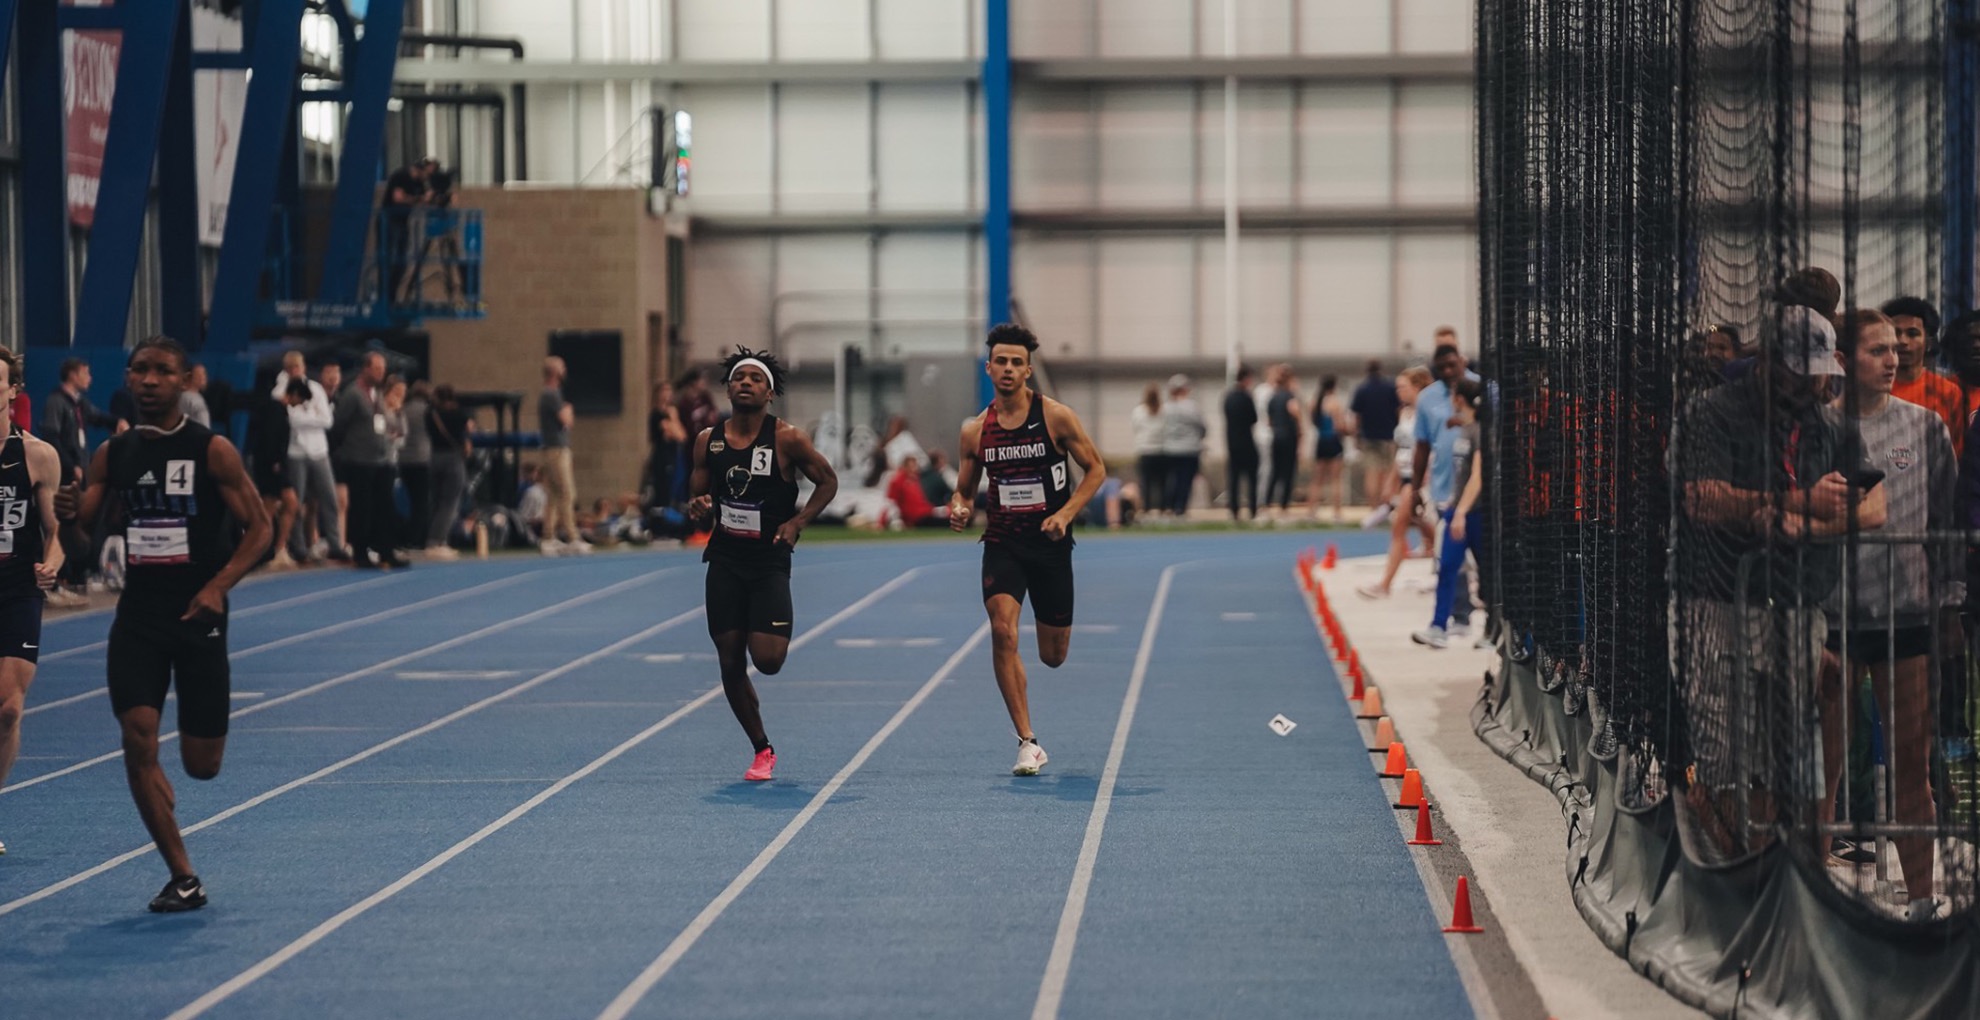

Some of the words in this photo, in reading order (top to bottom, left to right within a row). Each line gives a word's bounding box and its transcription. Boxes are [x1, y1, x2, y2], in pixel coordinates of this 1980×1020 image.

[754, 451, 767, 471] 3
[985, 448, 996, 462] IU
[998, 443, 1046, 461] KOKOMO
[170, 464, 187, 489] 4
[1054, 466, 1064, 486] 2
[8, 503, 23, 525] 5
